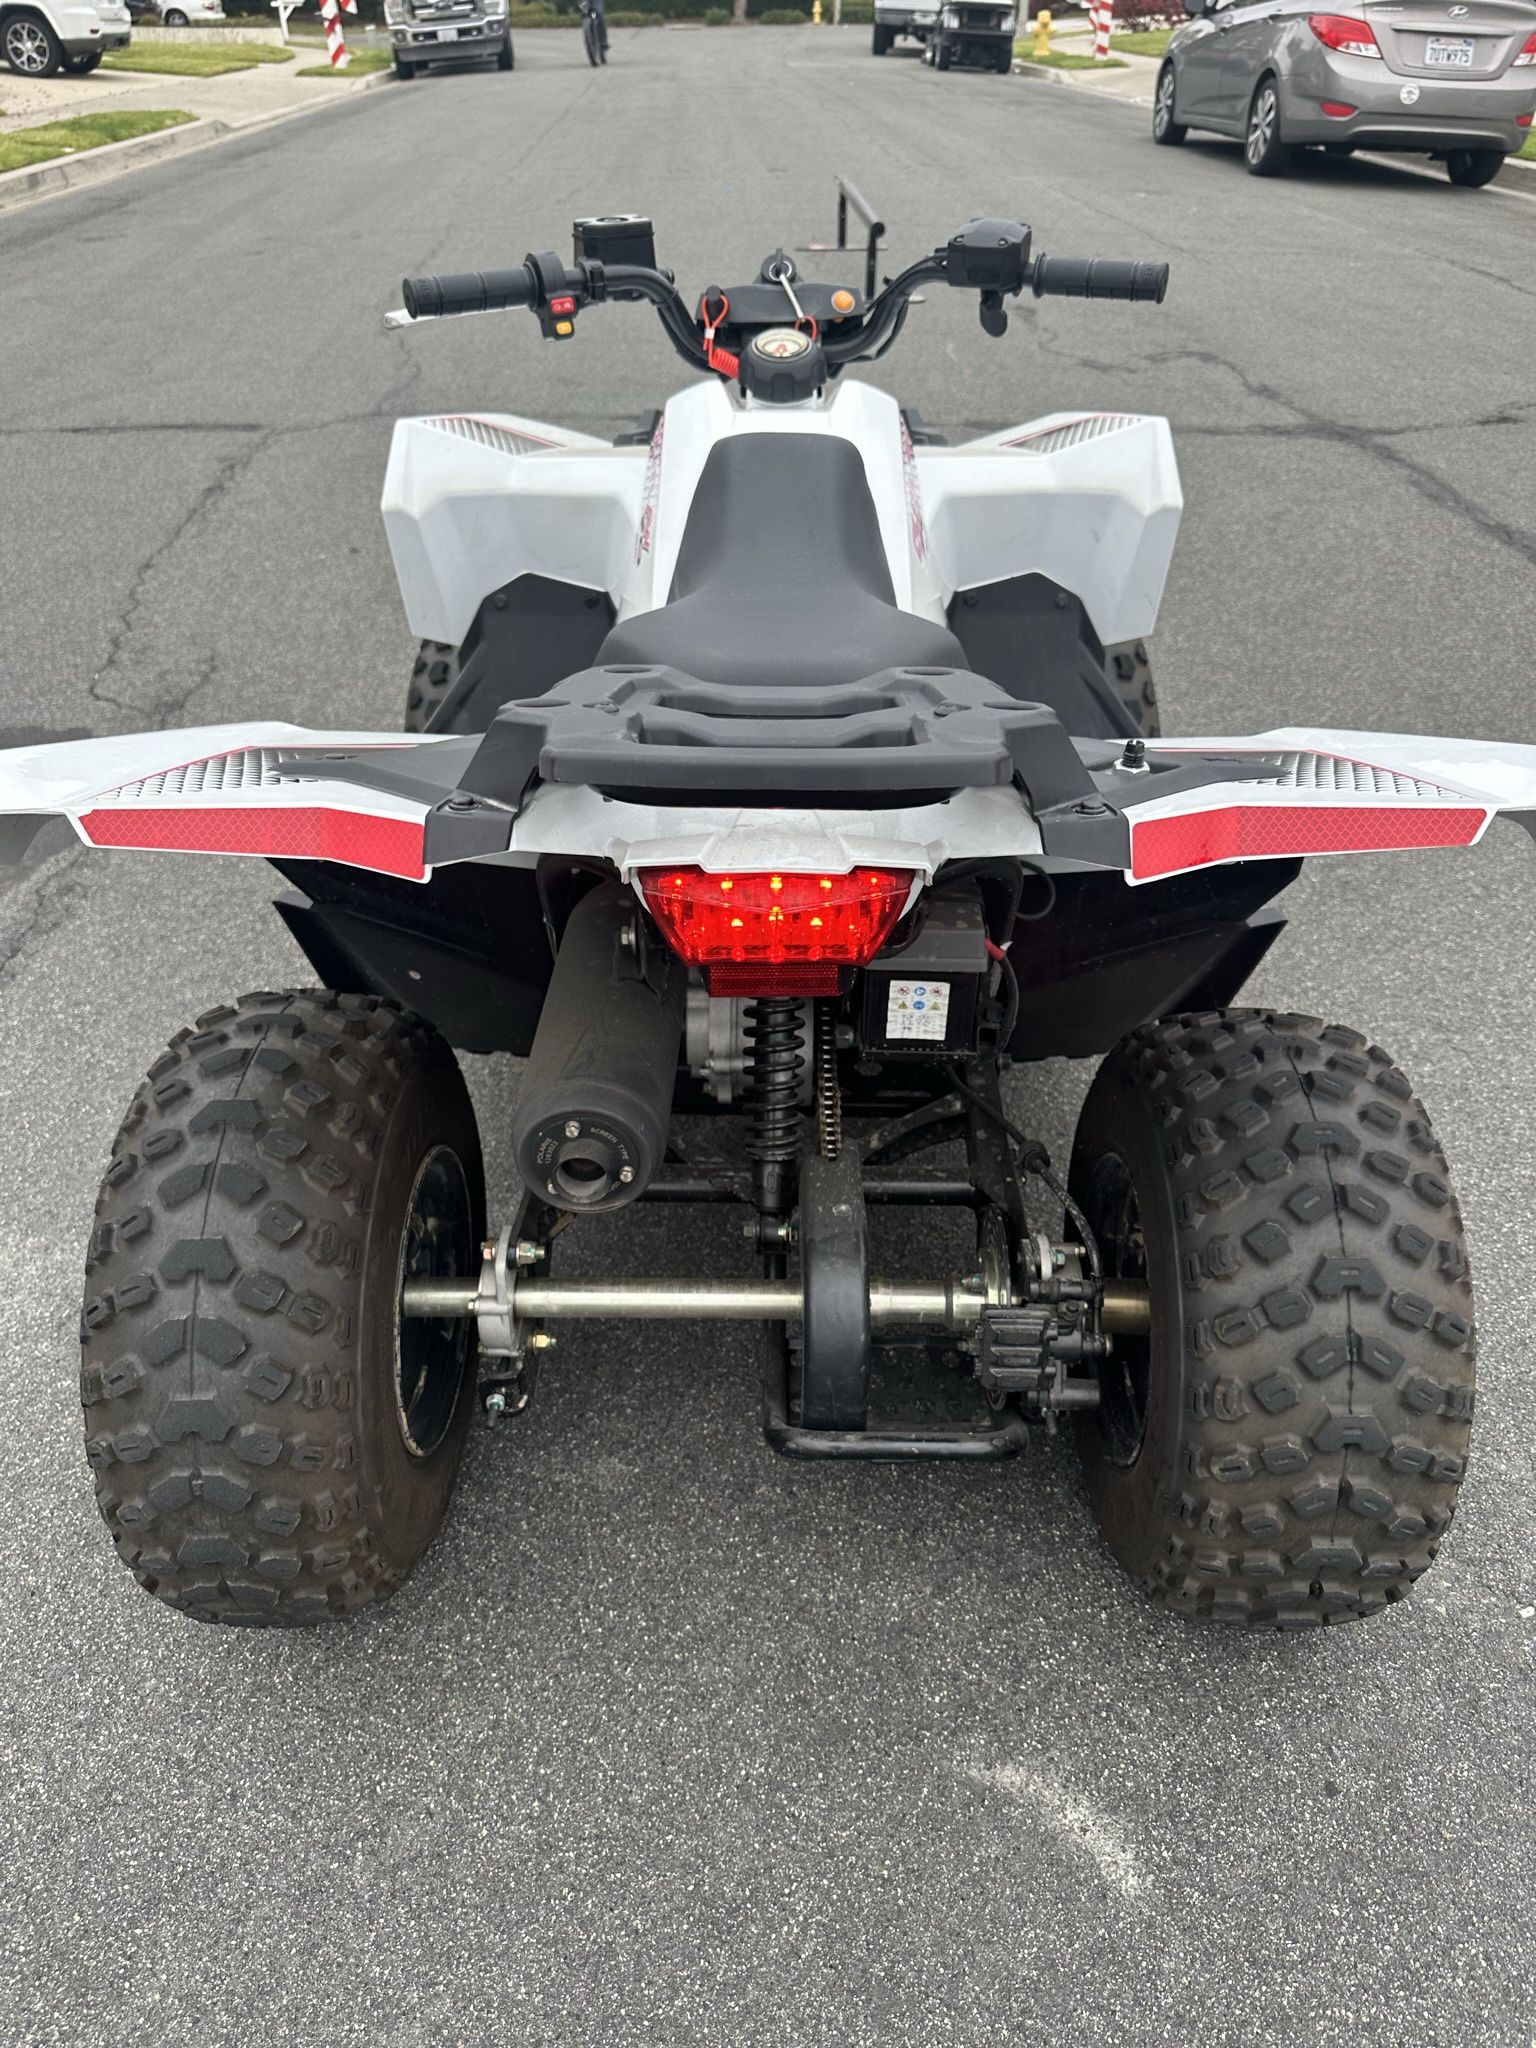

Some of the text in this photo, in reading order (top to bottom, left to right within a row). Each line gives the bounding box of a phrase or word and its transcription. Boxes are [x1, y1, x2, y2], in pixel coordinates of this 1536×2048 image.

[537, 1137, 552, 1164] POLARIS
[590, 1127, 629, 1160] SCREEN TYPE
